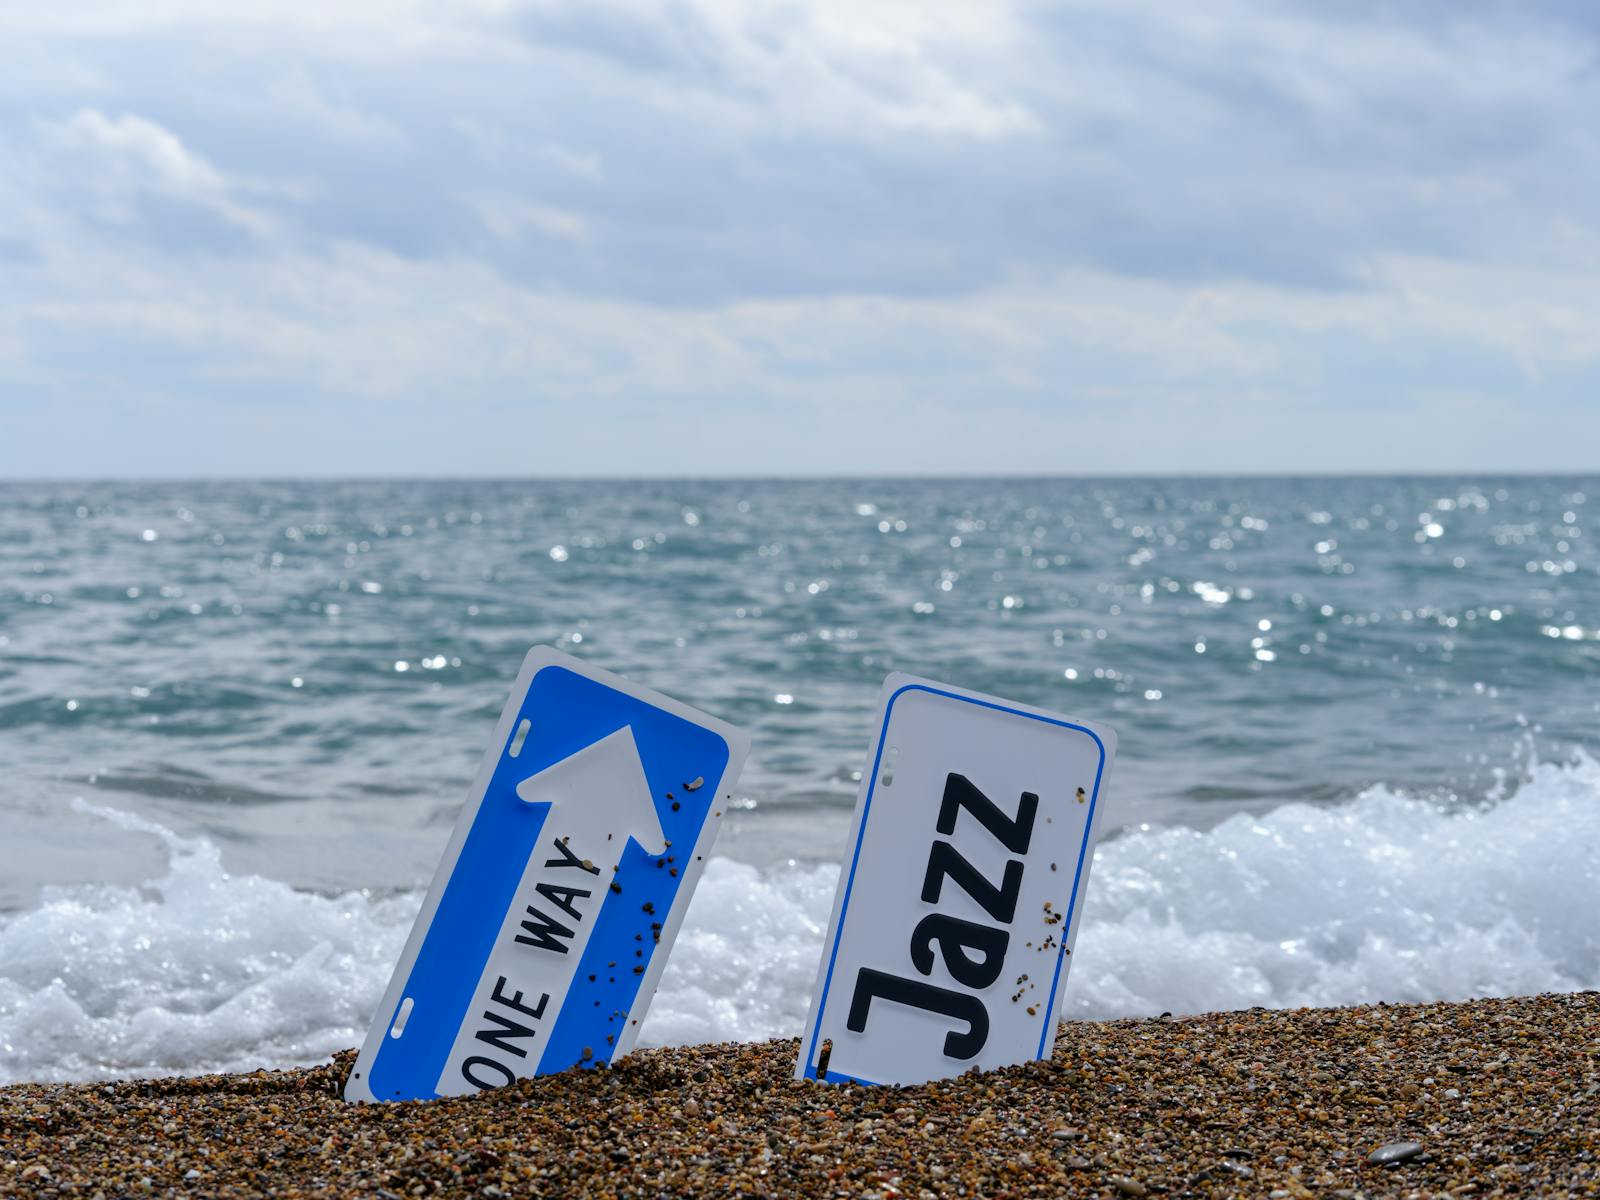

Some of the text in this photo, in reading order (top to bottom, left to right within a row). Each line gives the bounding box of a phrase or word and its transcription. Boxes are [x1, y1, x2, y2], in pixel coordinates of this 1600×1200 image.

[461, 837, 601, 1091] ONE WAY
[846, 772, 1040, 1061] Jazz
